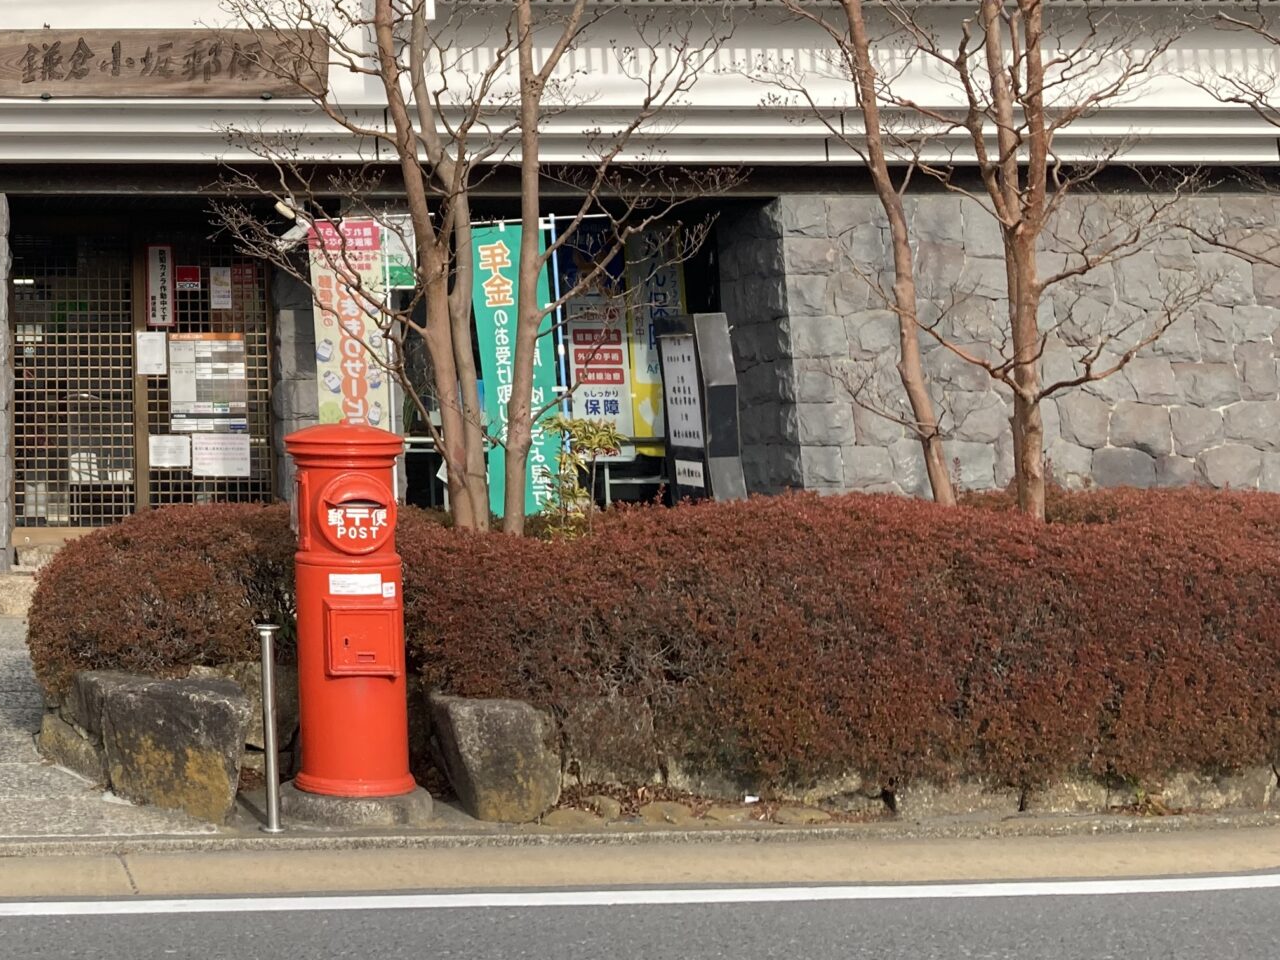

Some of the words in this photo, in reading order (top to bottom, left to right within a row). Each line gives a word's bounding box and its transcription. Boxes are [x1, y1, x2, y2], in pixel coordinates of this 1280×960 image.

[583, 389, 619, 397] もしっかり
[584, 398, 620, 416] 保障
[337, 526, 378, 539] POST
